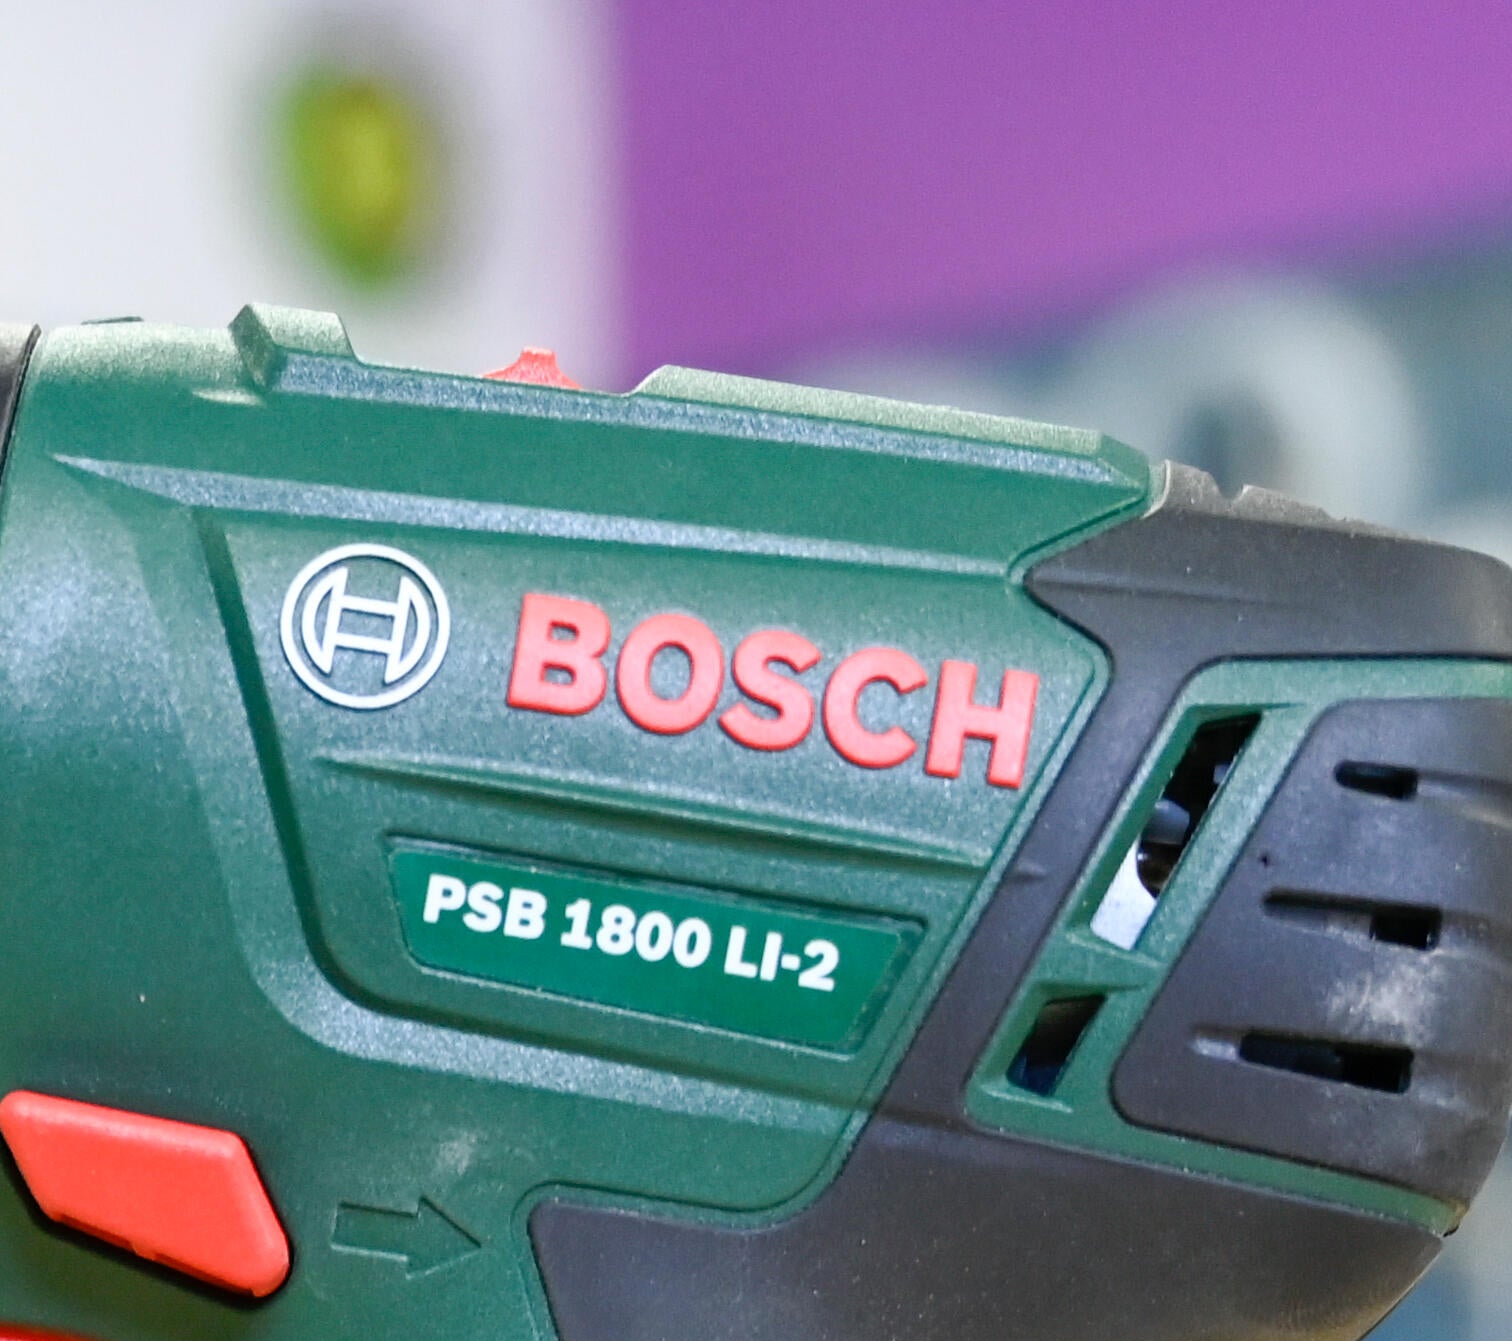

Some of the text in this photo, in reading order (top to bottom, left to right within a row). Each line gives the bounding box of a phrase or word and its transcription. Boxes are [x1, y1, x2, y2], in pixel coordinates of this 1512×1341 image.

[505, 591, 1042, 790] BOSCH
[422, 872, 840, 992] PSB 1800 LI-2
